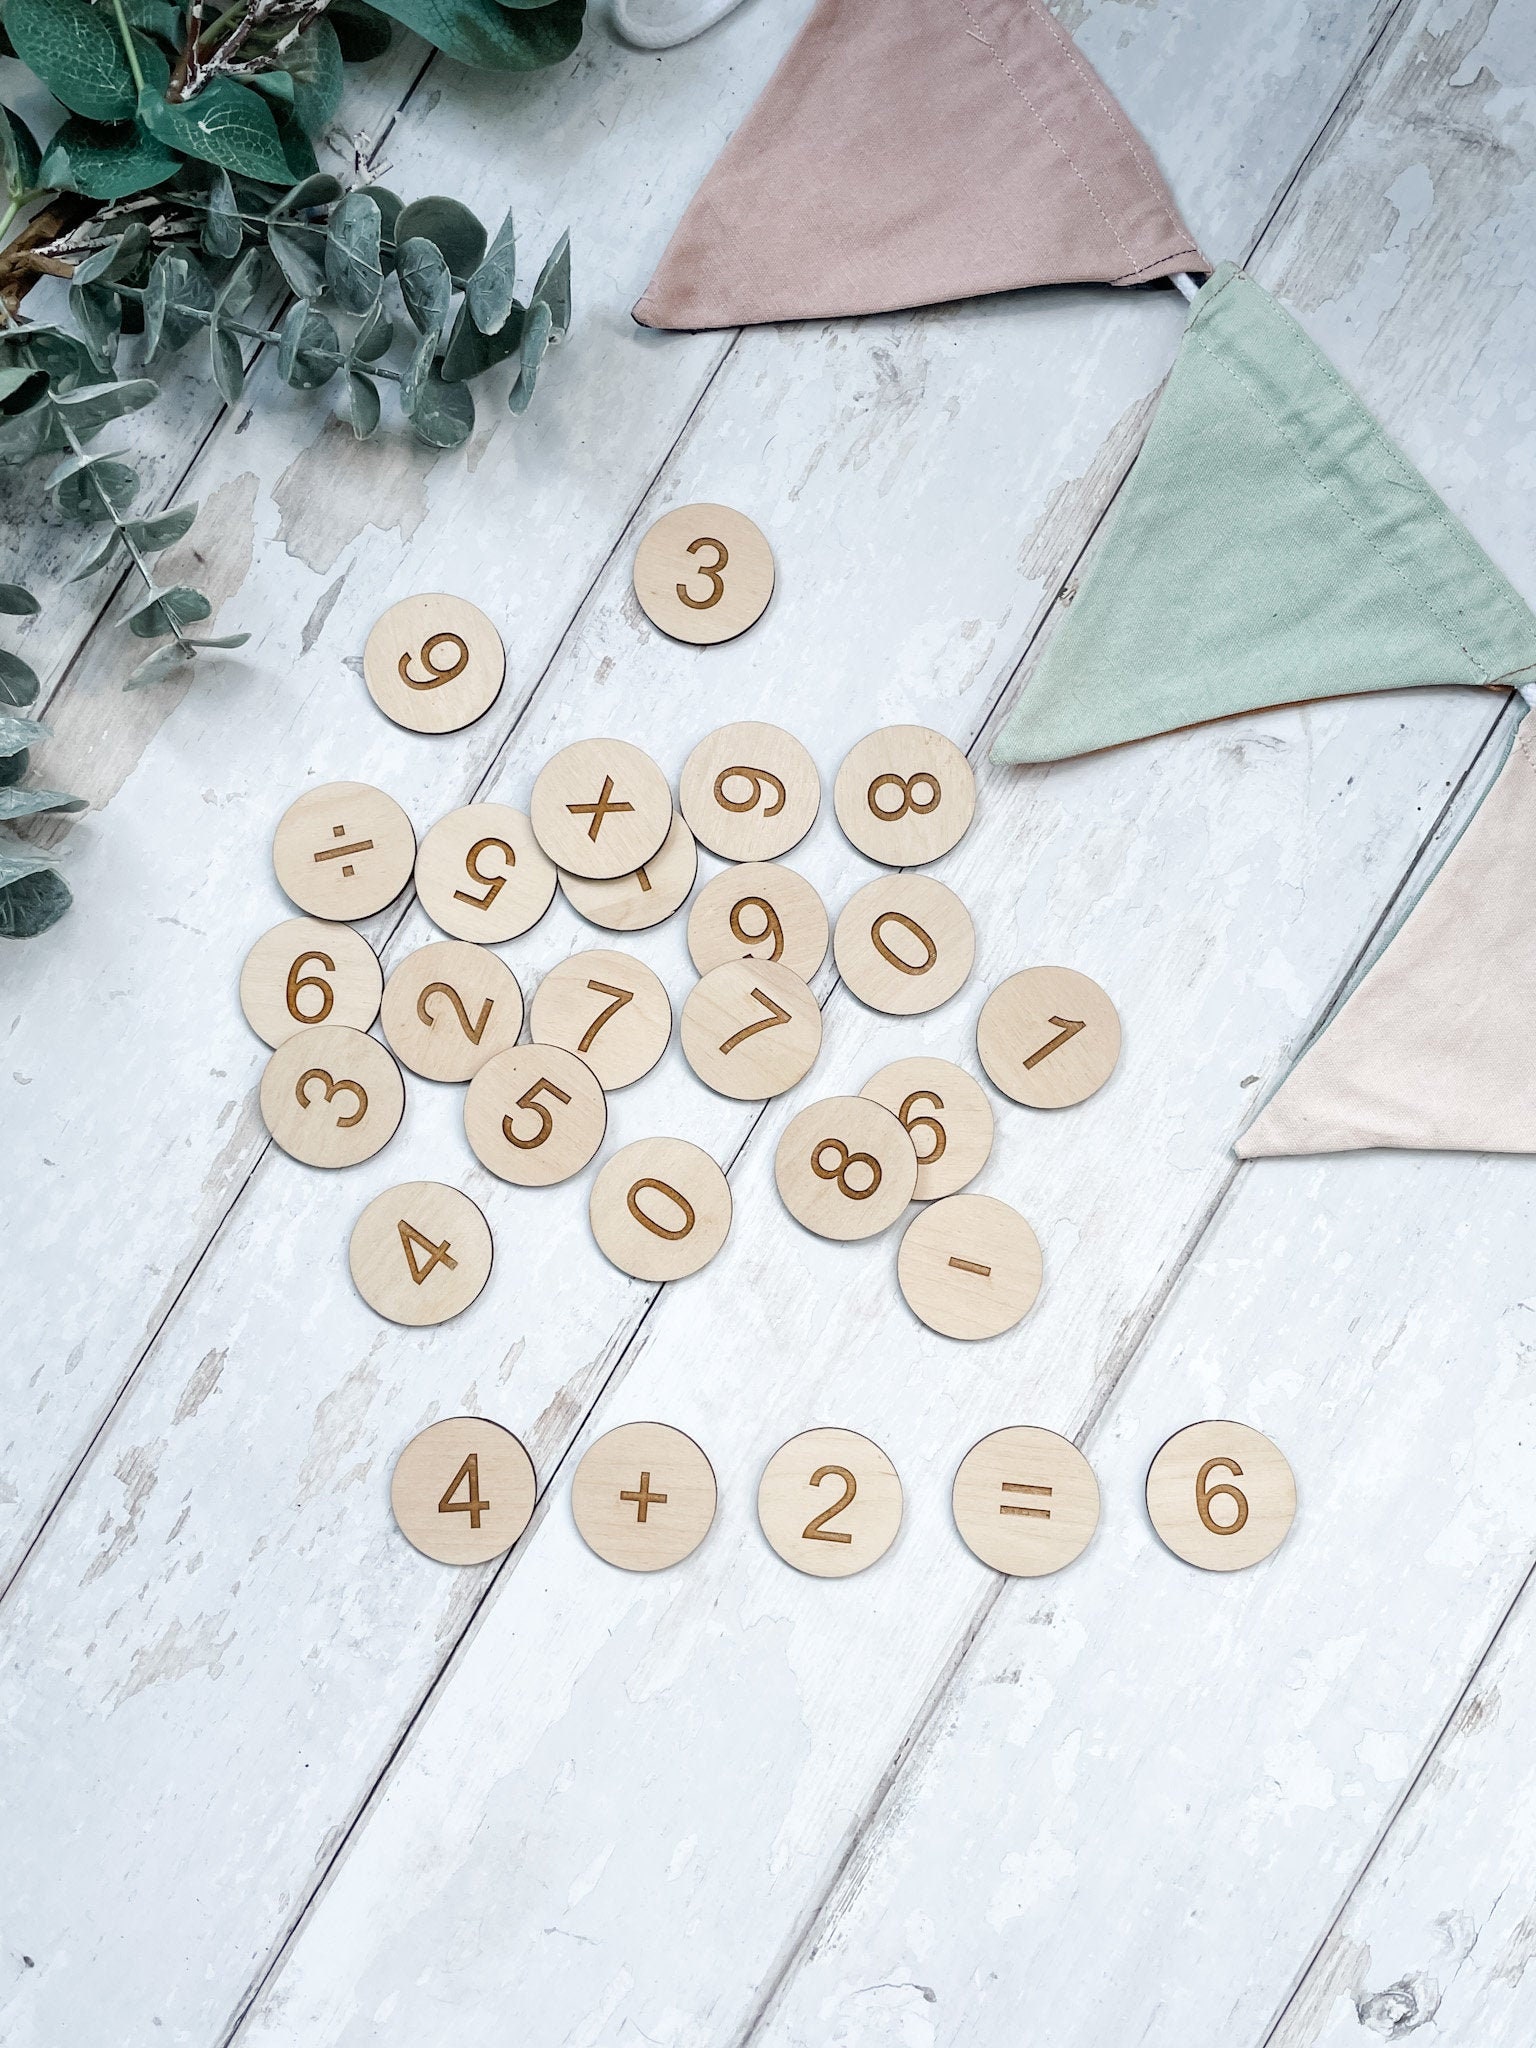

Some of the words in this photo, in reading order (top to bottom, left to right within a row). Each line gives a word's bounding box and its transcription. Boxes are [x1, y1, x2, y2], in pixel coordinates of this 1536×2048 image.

[676, 538, 729, 610] 3
[867, 772, 942, 822] 8
[452, 837, 517, 912] 5
[869, 911, 938, 977] 0
[285, 950, 337, 1025] 6
[416, 981, 494, 1047] 2
[577, 979, 635, 1054] 7
[719, 988, 793, 1056] 7
[1022, 1015, 1087, 1072] 1
[295, 1068, 369, 1129] 3
[502, 1077, 572, 1151] 5
[897, 1090, 948, 1167] 6
[810, 1137, 883, 1202] 8
[626, 1177, 697, 1242] 0
[396, 1218, 459, 1287] 4
[438, 1452, 491, 1530] 4
[619, 1470, 669, 1524] +
[801, 1465, 858, 1546] 2
[1195, 1456, 1249, 1536] 6
